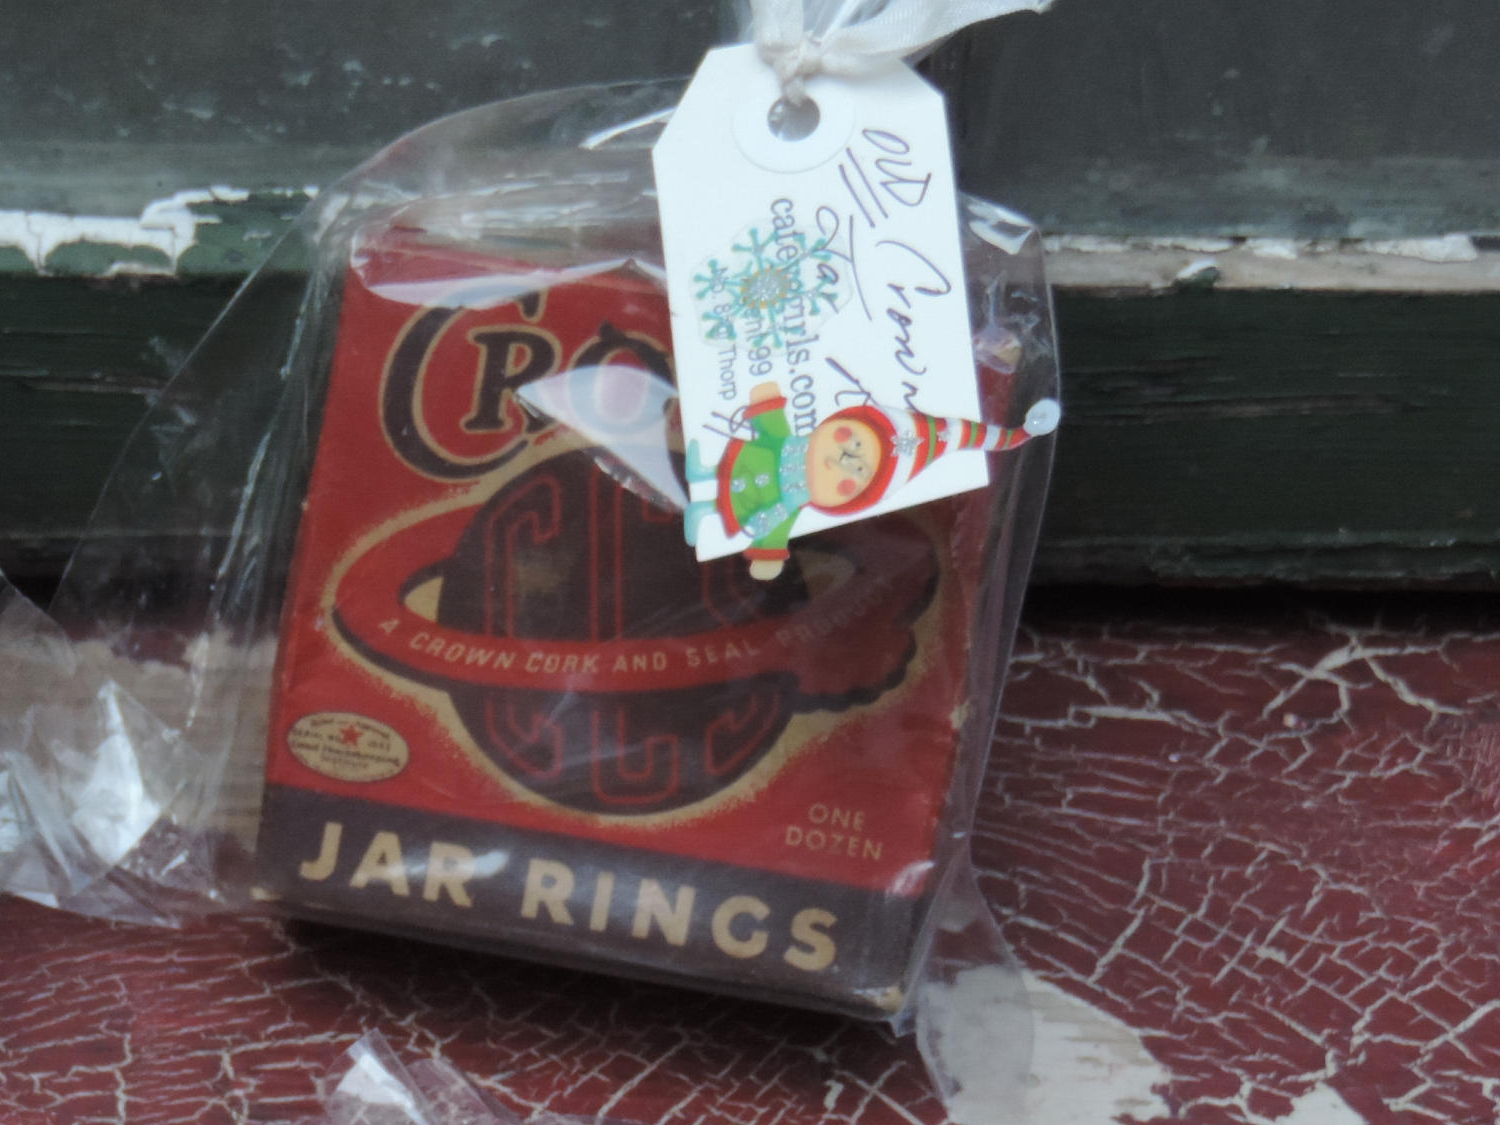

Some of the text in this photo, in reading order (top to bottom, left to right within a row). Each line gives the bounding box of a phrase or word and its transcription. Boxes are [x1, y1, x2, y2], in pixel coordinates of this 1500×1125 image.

[377, 616, 398, 636] A
[409, 631, 516, 672] CROWN
[524, 650, 600, 675] CORK
[612, 650, 668, 673] AND
[685, 636, 762, 669] SEAL
[807, 802, 867, 832] ONE
[784, 823, 885, 863] DOZEN
[300, 821, 840, 973] JAR RINGS
